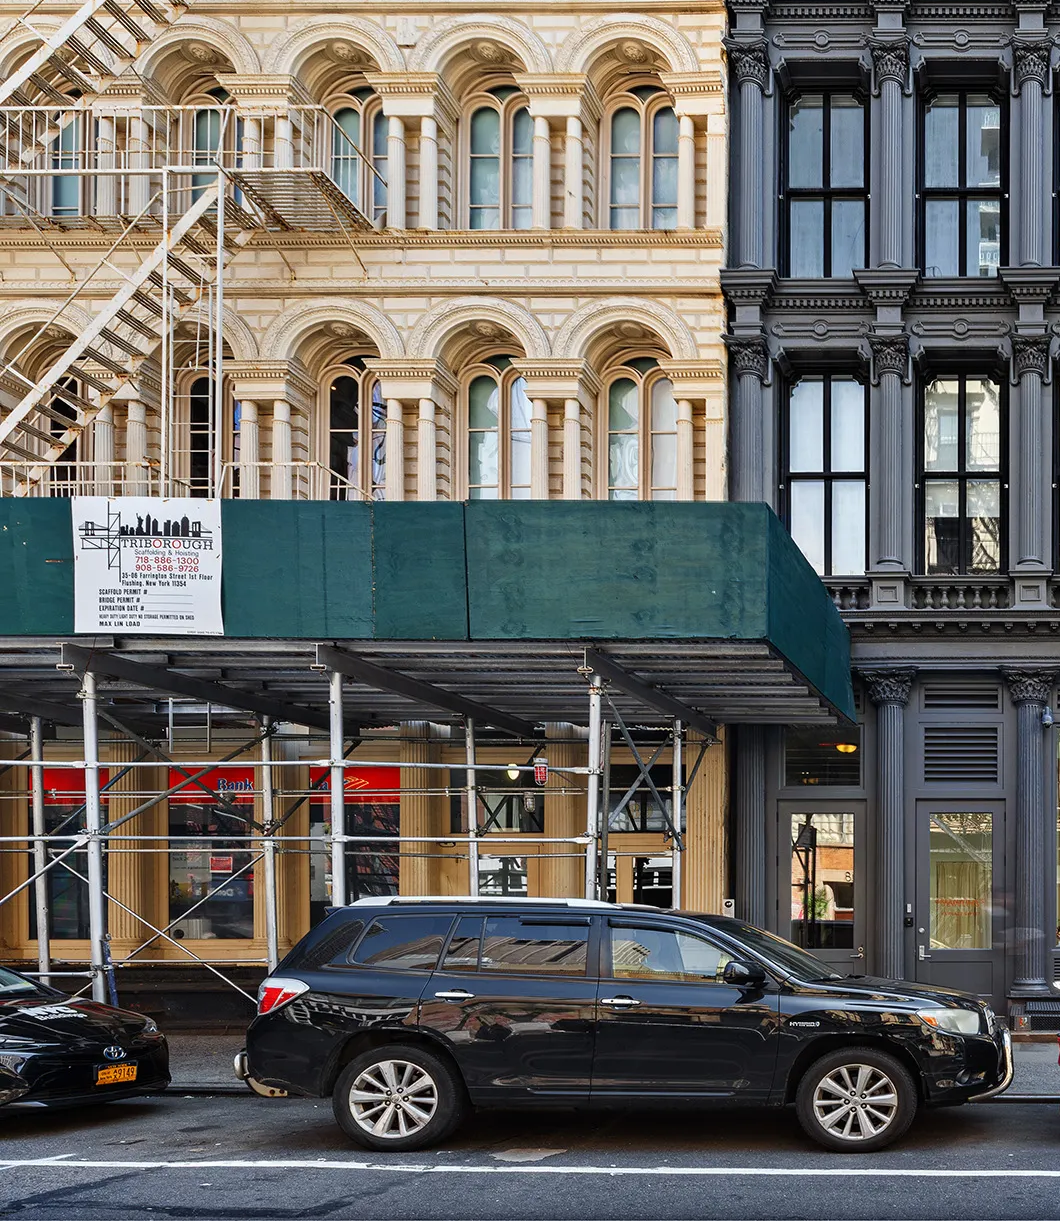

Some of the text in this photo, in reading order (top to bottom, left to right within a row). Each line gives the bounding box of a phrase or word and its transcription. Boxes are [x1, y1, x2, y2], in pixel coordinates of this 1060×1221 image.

[121, 539, 213, 550] TRIBOROUGH
[134, 549, 166, 557] Scaffolding
[135, 556, 199, 565] 718-886-1300
[135, 564, 199, 573] 908-586-9726
[199, 573, 213, 581] Floor
[217, 778, 254, 792] Bank
